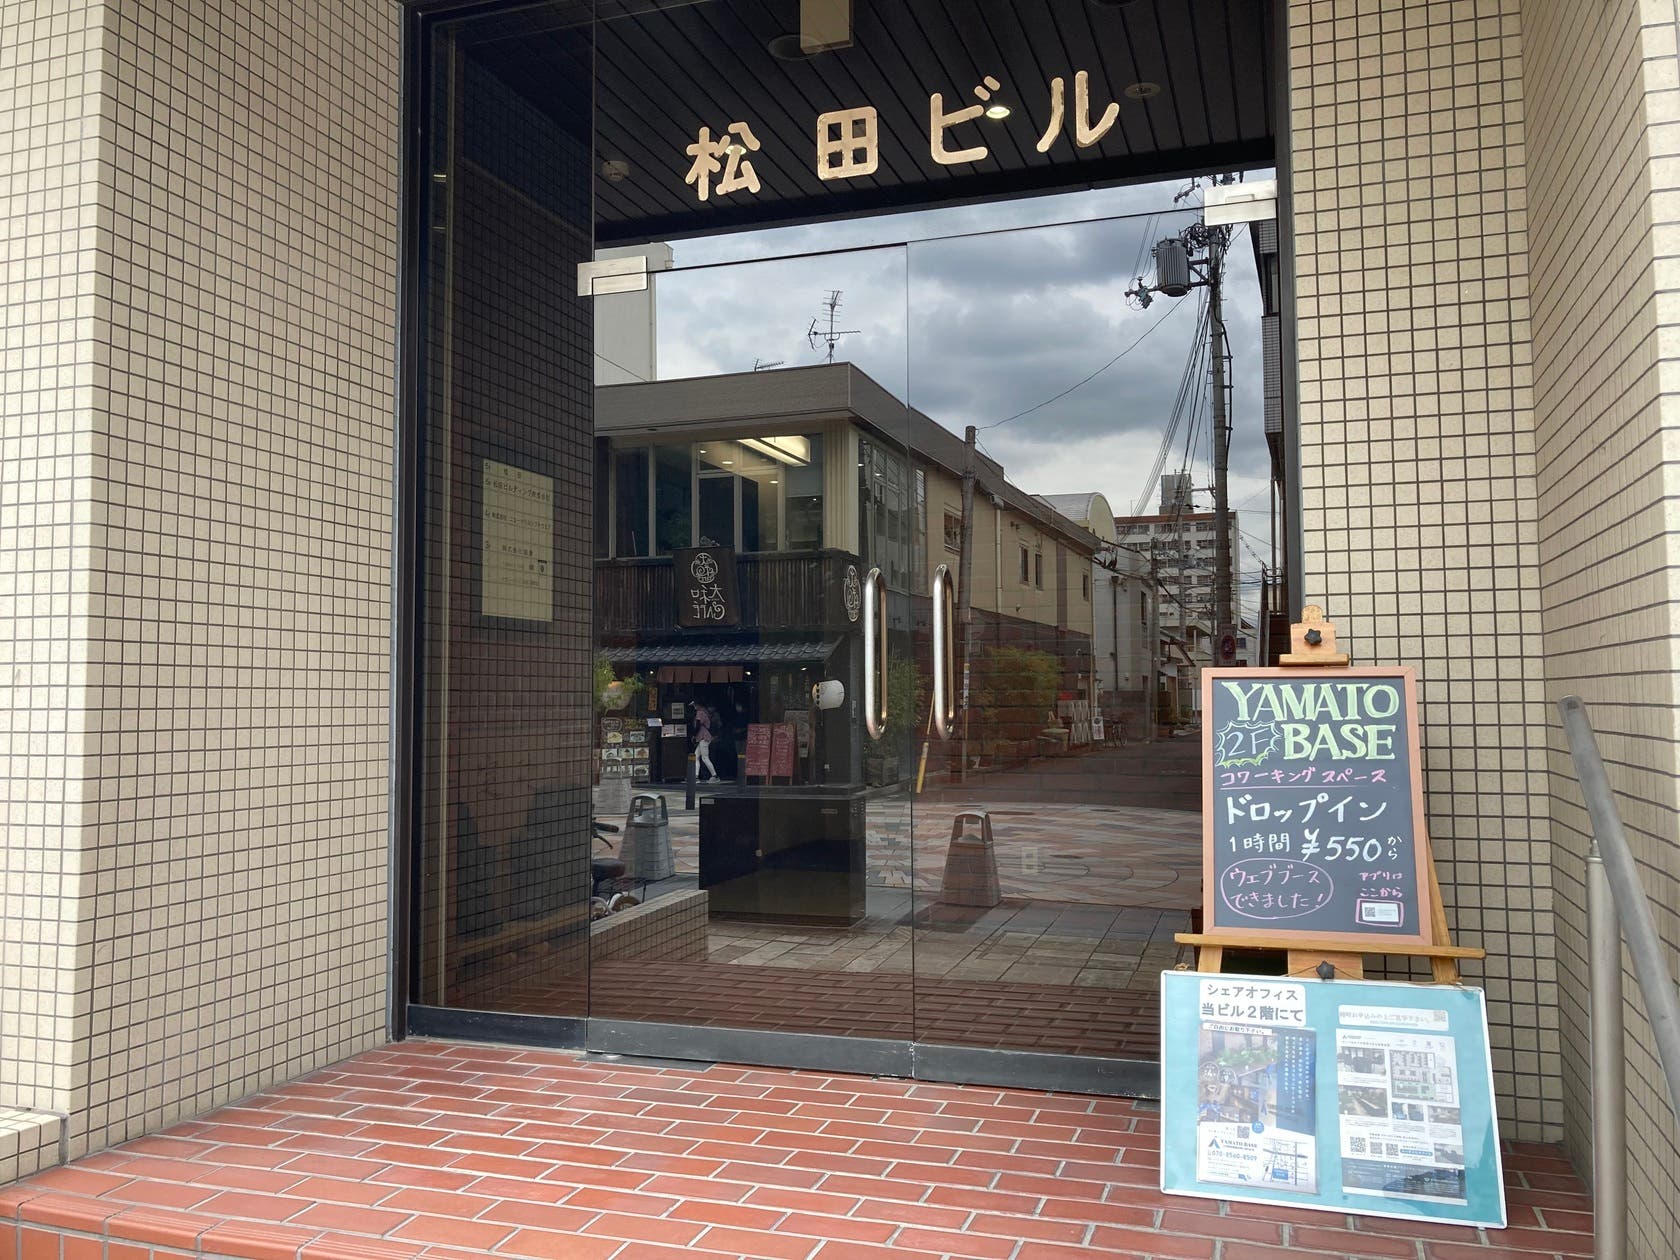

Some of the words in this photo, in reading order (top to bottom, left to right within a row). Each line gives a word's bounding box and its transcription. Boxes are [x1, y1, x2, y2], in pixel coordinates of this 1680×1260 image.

[685, 70, 1120, 201] 松田ビル
[1220, 681, 1400, 721] YAMATO
[1226, 727, 1269, 757] 2F
[1280, 723, 1397, 761] BASE
[1220, 766, 1315, 787] コワーキング
[1322, 767, 1387, 783] スペース
[1226, 792, 1387, 825] ドロップイン
[1229, 832, 1290, 854] 1時間
[1229, 864, 1320, 887] ウェブブース
[1359, 886, 1403, 898] ここから
[1207, 983, 1298, 1001] シェアオフィス
[1201, 1002, 1304, 1022] 当ビル2階にて
